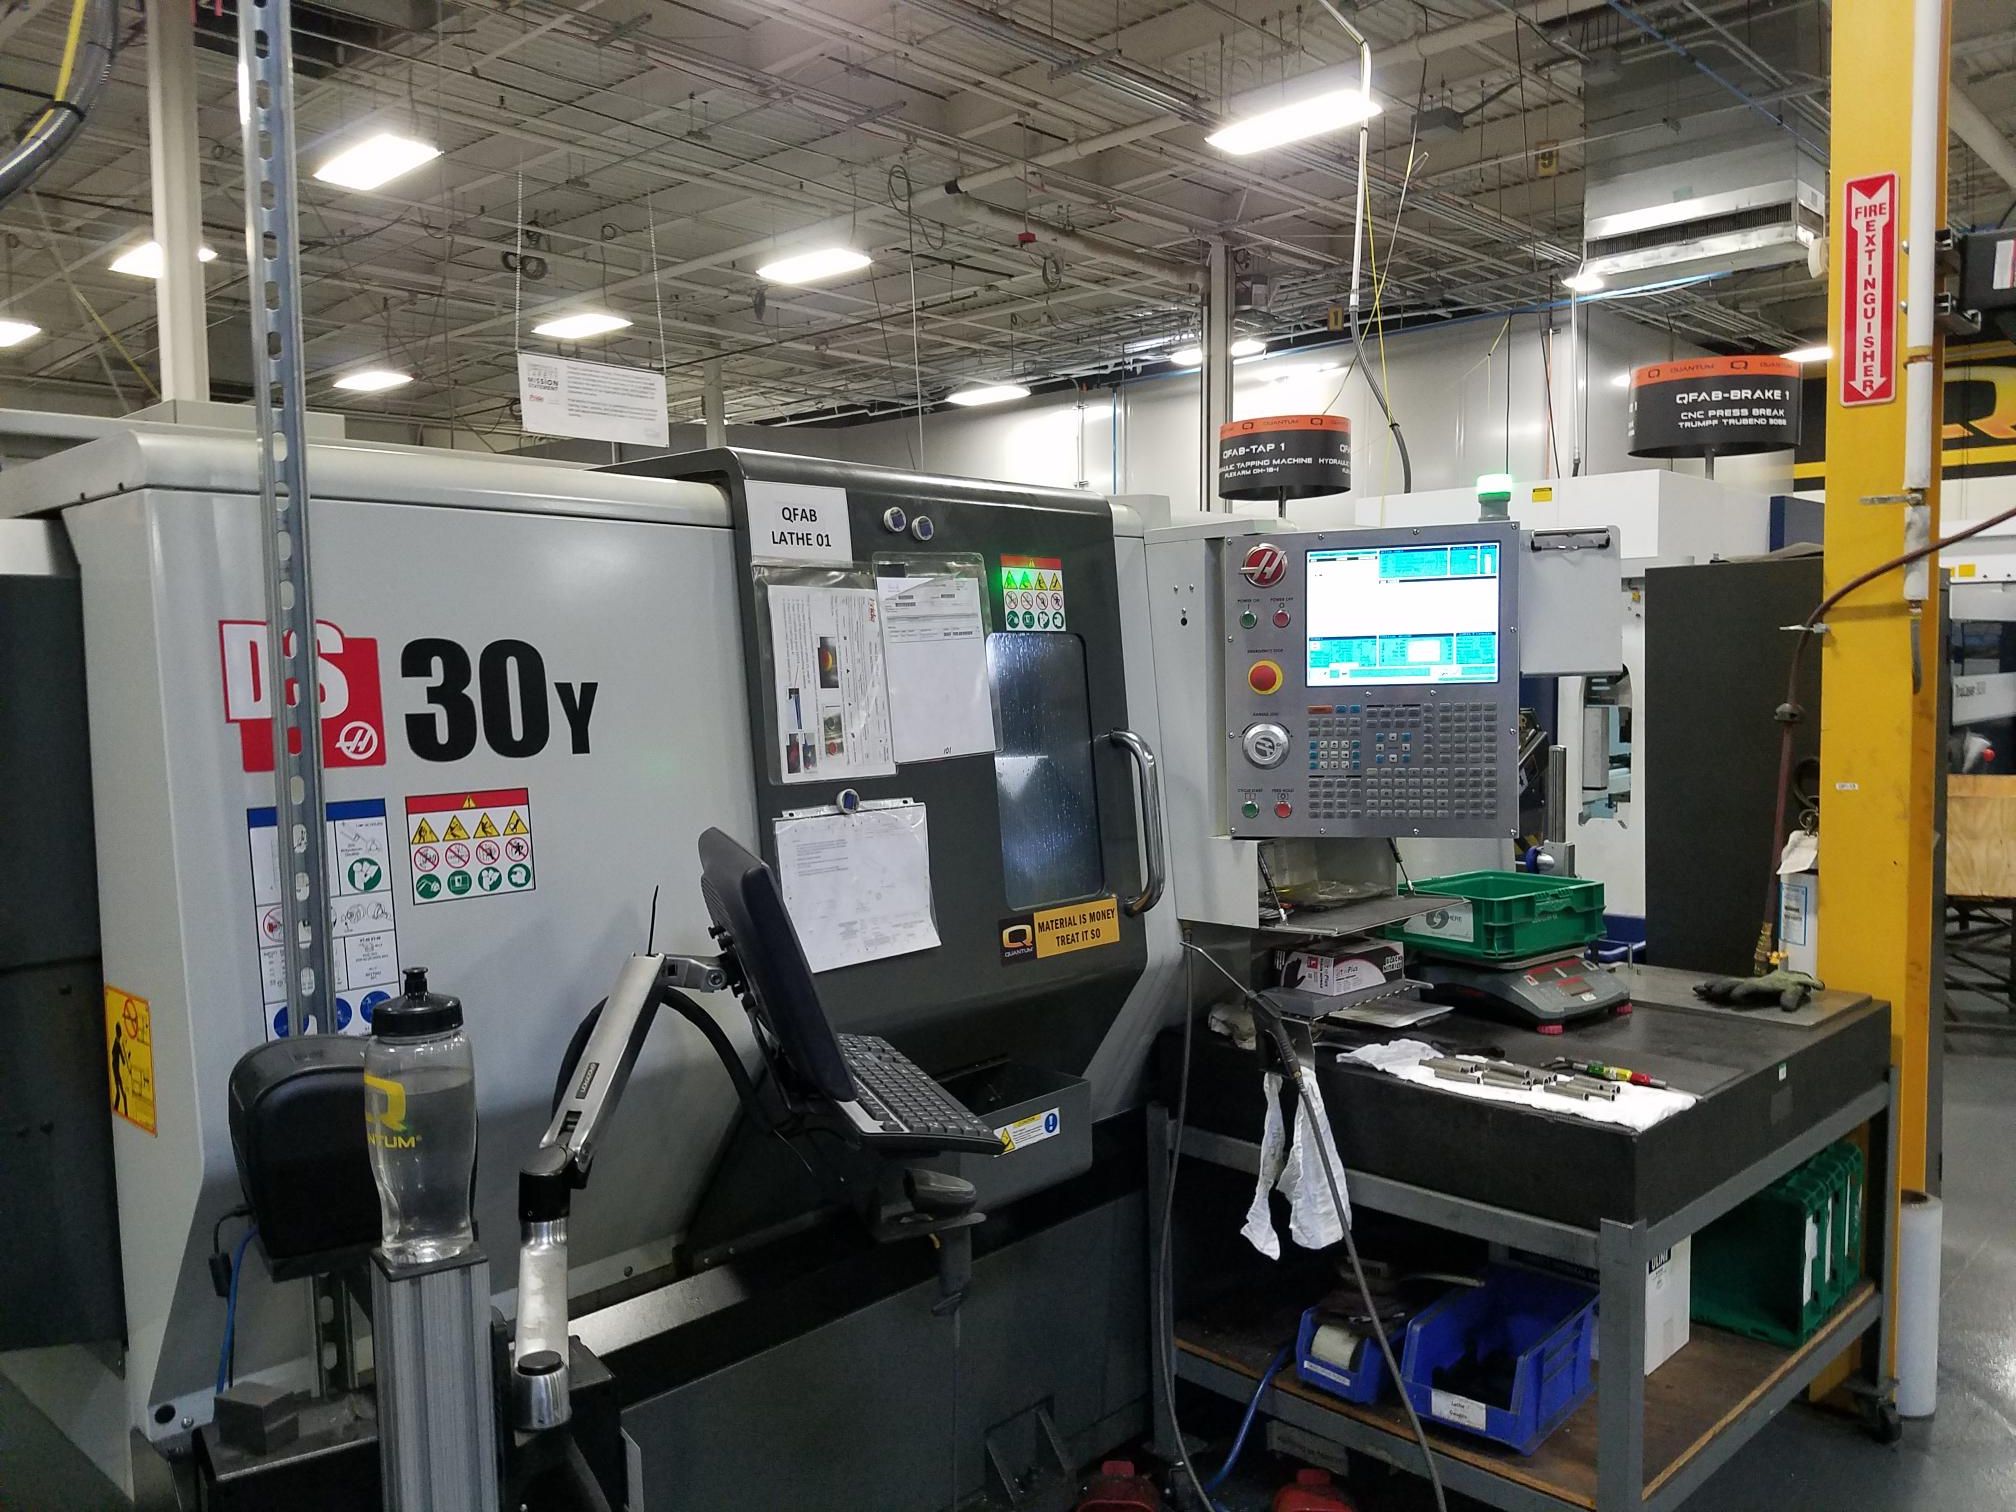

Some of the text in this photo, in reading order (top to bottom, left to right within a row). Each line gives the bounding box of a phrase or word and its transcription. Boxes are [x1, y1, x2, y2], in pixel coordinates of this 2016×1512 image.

[1854, 201, 1887, 220] FIRE
[1861, 219, 1877, 392] EXTINGUISHER
[528, 376, 559, 387] MISSION
[528, 382, 559, 392] STATEMENT
[1676, 389, 1790, 405] QFAB-BRAKE 1
[1681, 407, 1785, 420] CNC PRESS BREAK
[1678, 419, 1719, 429] TRUMPF
[1722, 418, 1767, 426] TRUBEND
[1222, 442, 1285, 459] QFAB-TAP 1
[1236, 460, 1270, 469] TAPPING
[1272, 457, 1313, 465] MACHINE
[781, 506, 818, 523] QFAB
[771, 531, 832, 547] LATHE 01
[1037, 908, 1116, 933] MATERIAL IS MONEY
[1056, 928, 1101, 947] TREAT IT SO
[1004, 946, 1033, 958] QUANTUM
